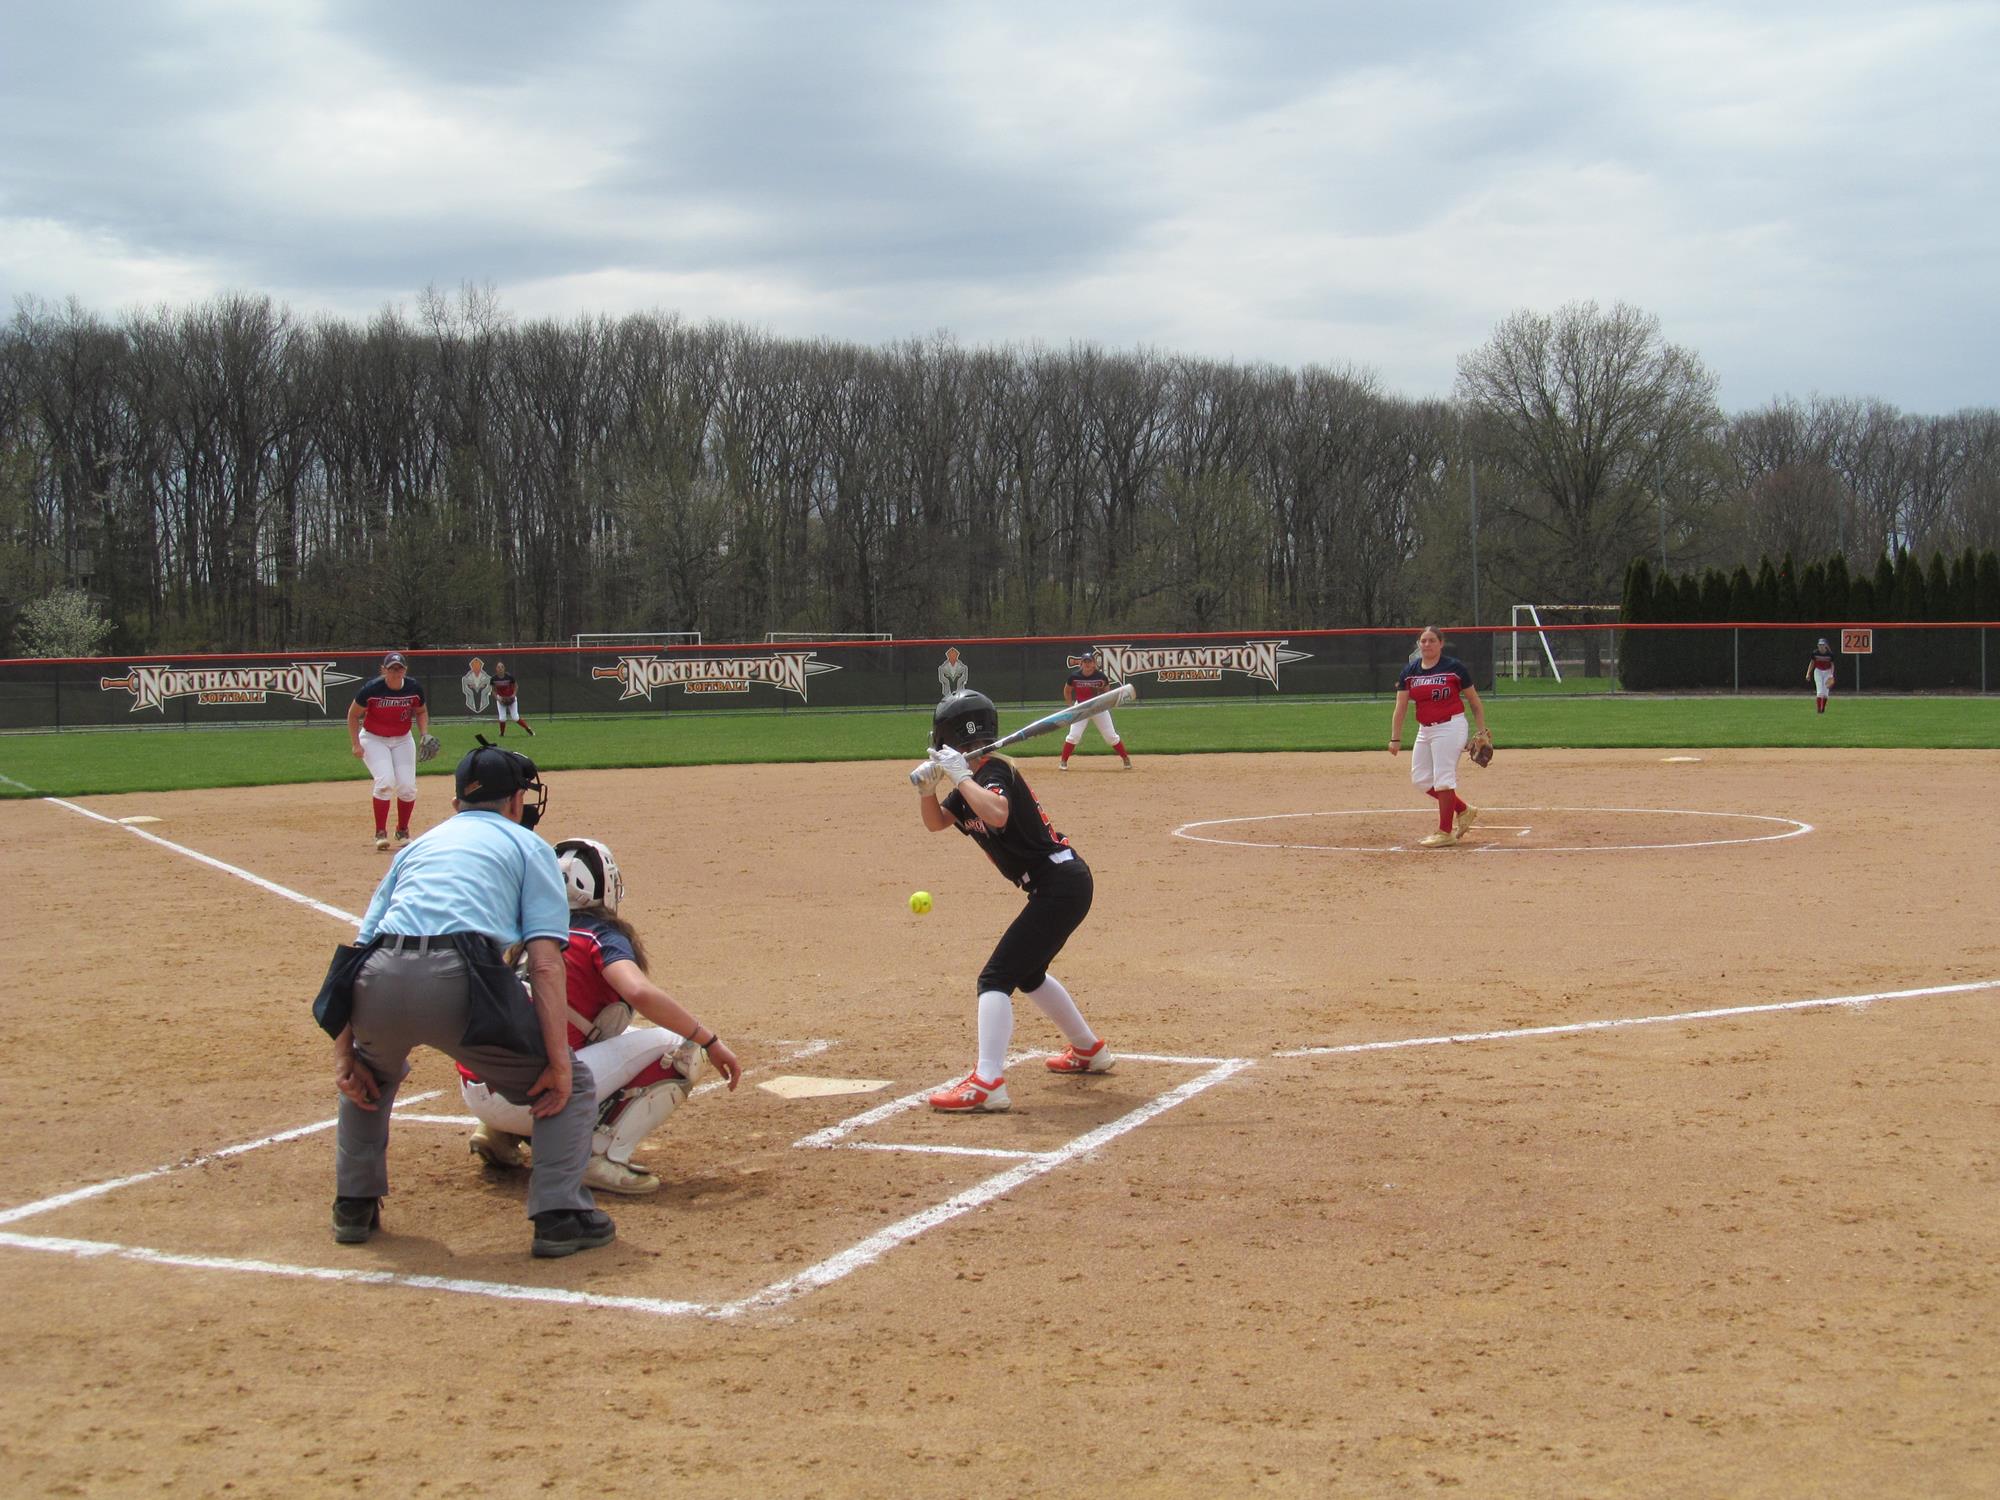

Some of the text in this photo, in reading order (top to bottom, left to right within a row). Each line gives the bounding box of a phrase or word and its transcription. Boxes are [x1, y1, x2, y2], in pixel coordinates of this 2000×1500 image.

[1845, 634, 1869, 648] 220
[1094, 641, 1281, 691] NORTHAMPTON
[619, 654, 808, 701] NORTHAMPTON
[1159, 669, 1221, 680] SOFTBALL
[130, 664, 328, 712] NORTHAMPTON
[686, 681, 748, 693] SOFTBALL
[200, 691, 264, 703] SOFTBALL
[966, 721, 976, 734] 9
